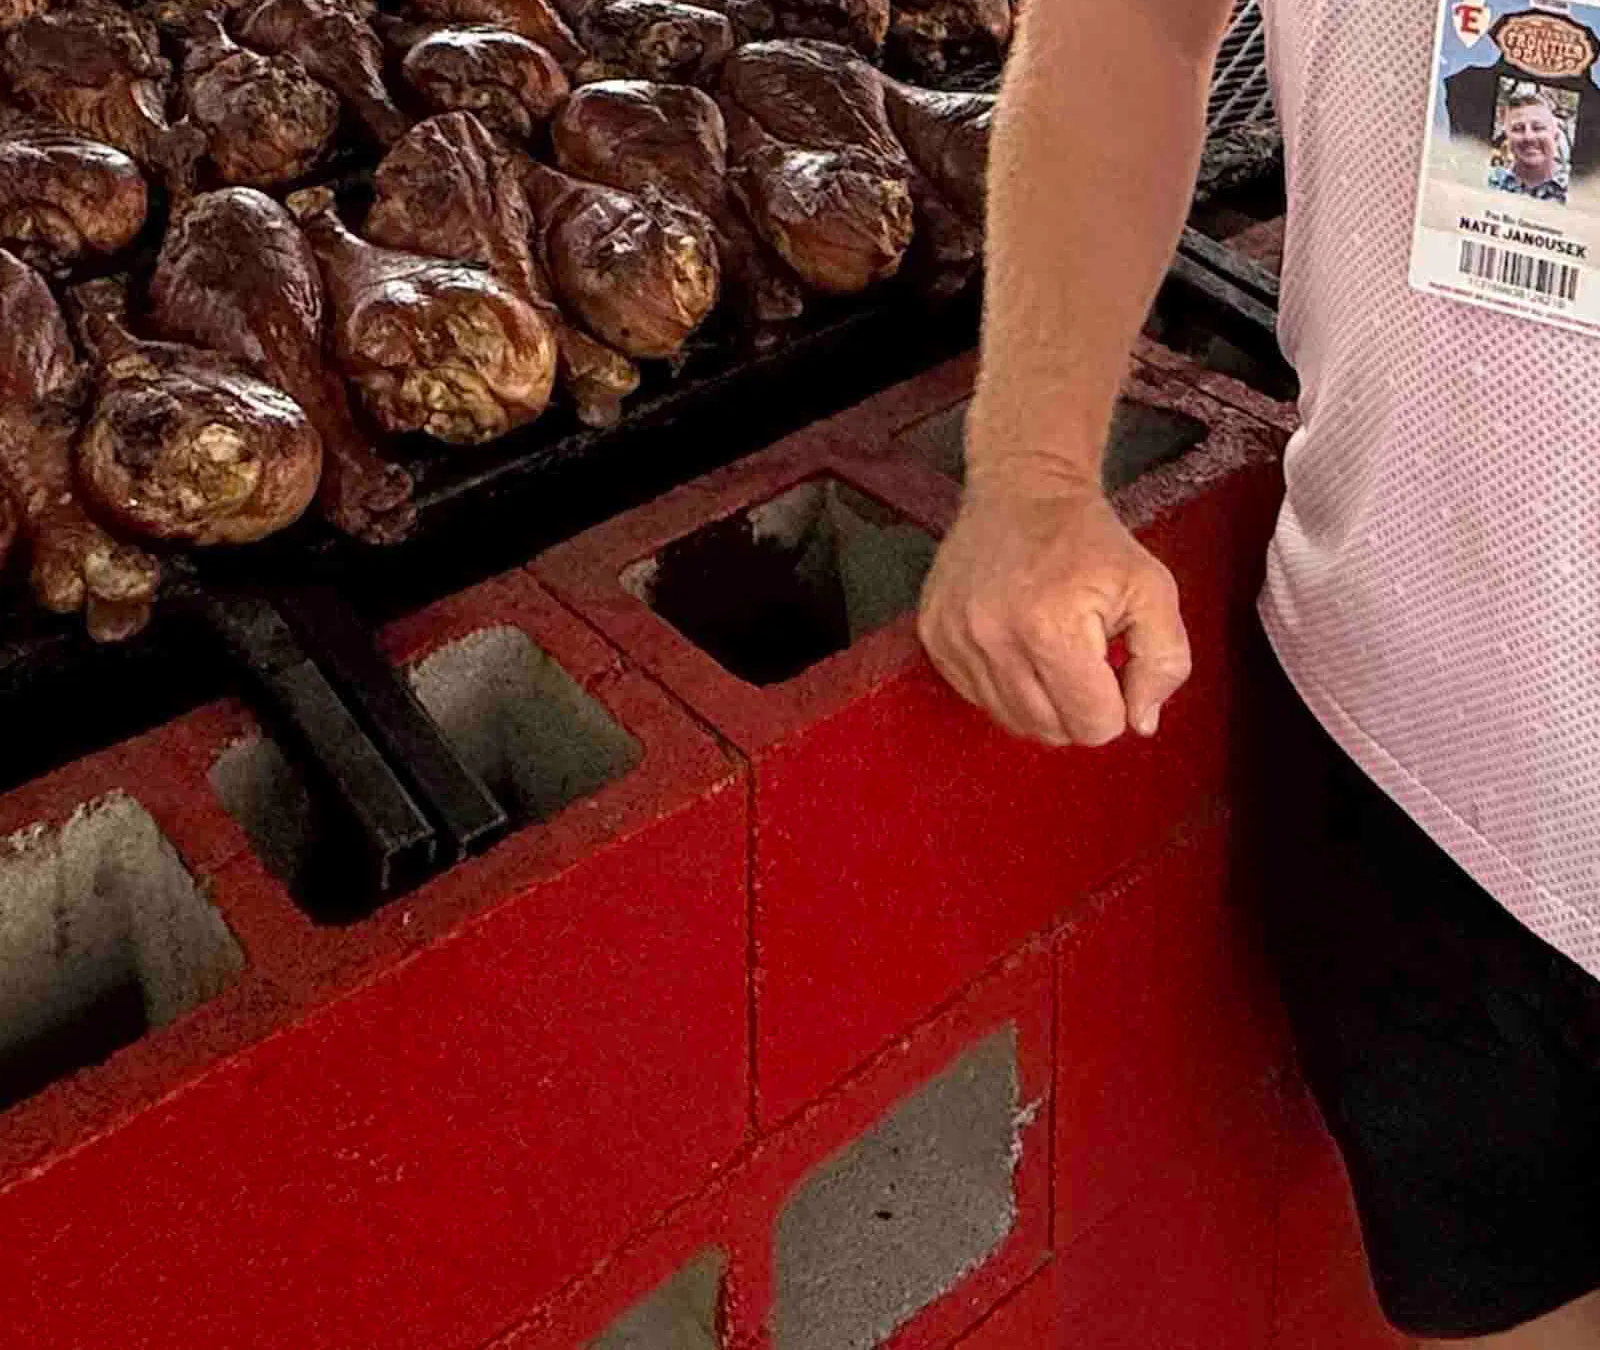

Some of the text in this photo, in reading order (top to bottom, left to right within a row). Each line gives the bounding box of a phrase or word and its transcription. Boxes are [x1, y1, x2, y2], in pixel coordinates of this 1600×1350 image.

[1454, 2, 1482, 35] E
[1459, 216, 1500, 239] NATE
[1502, 227, 1588, 260] JANOUSEK
